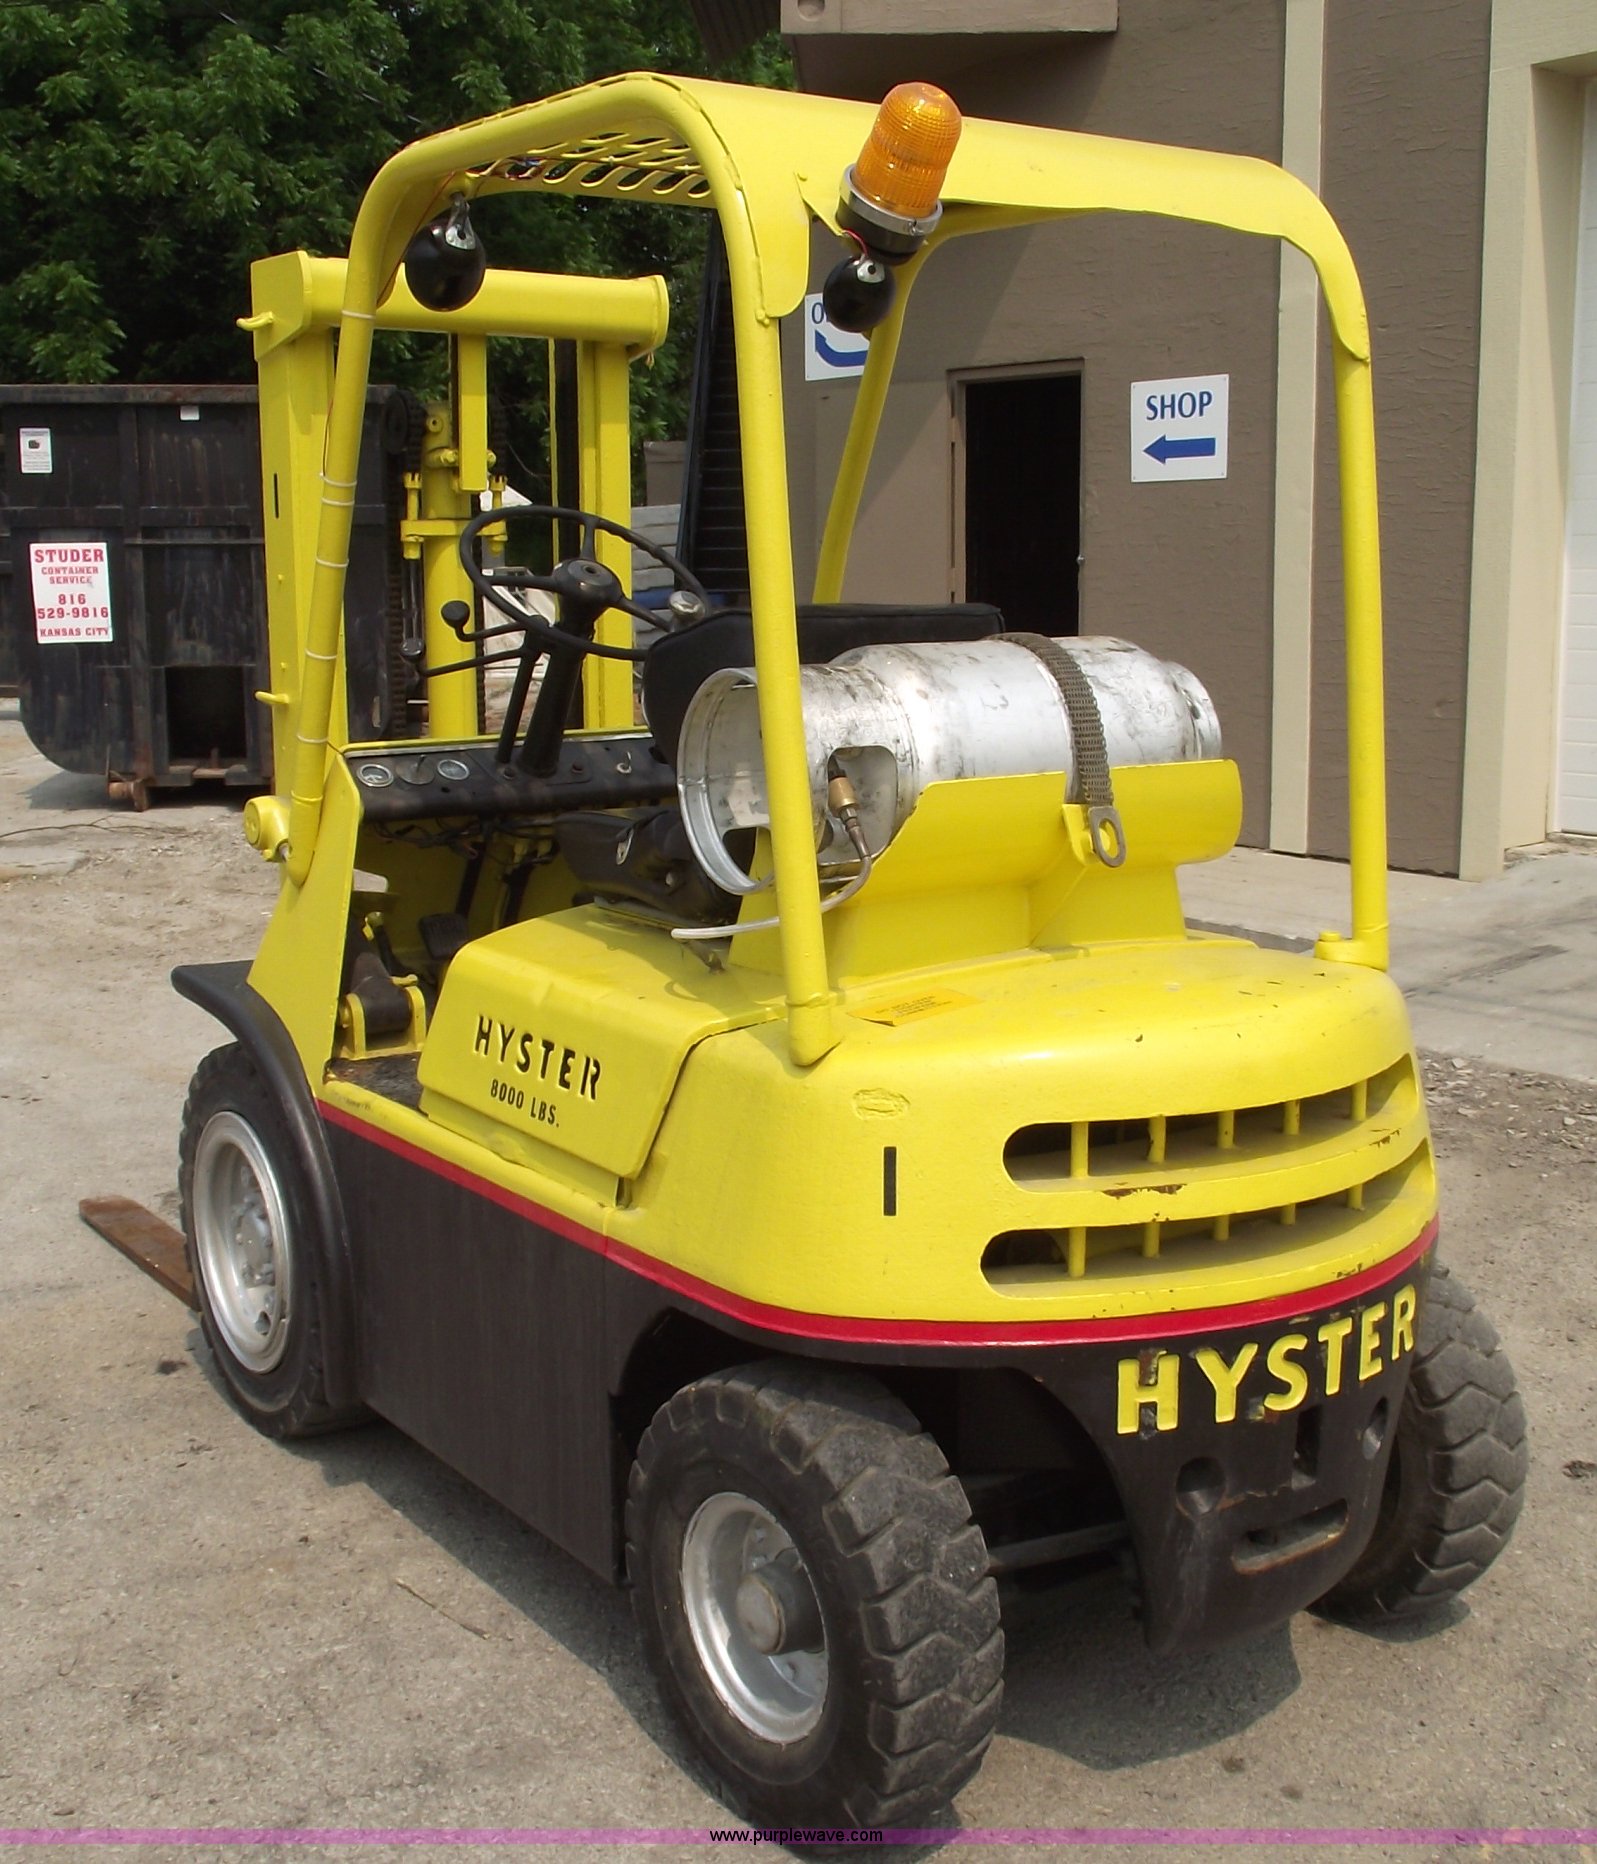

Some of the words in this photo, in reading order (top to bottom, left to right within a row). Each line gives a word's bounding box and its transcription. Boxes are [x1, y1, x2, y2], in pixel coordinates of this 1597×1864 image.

[1146, 391, 1213, 421] SHOP
[34, 549, 104, 563] STUDER
[41, 566, 99, 575] CONTAINER
[49, 575, 93, 585] SERVICE
[58, 593, 86, 605] 816
[37, 607, 109, 619] 529-9816
[40, 627, 81, 637] KANSAS
[85, 626, 109, 636] CITY
[474, 1015, 601, 1101] HYSTER
[490, 1078, 525, 1110] 8000
[530, 1096, 560, 1128] LBS.
[1117, 1283, 1416, 1435] HYSTER
